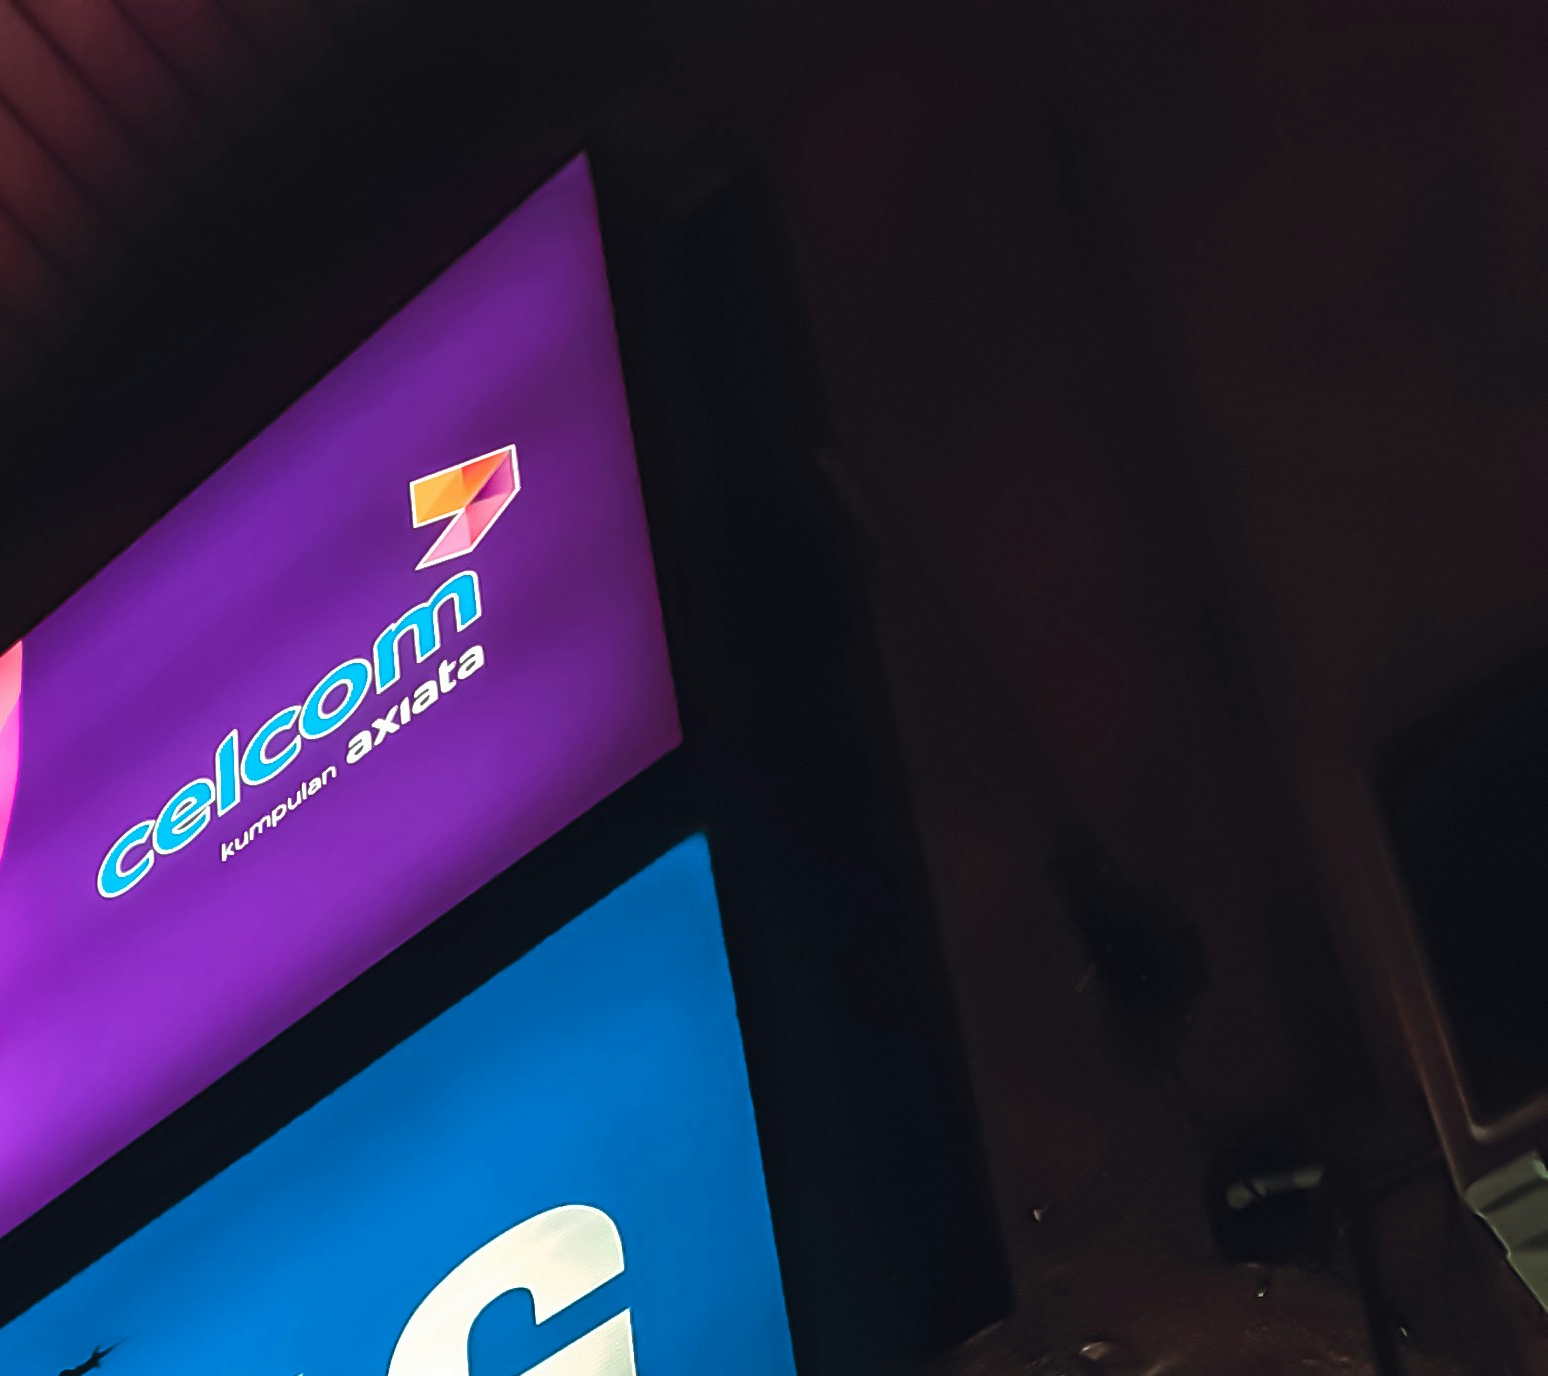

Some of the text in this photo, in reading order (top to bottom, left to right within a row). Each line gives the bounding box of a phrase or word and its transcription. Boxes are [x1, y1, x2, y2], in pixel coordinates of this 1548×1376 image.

[97, 570, 482, 899] celcom
[220, 645, 485, 862] kumpulan axiata
